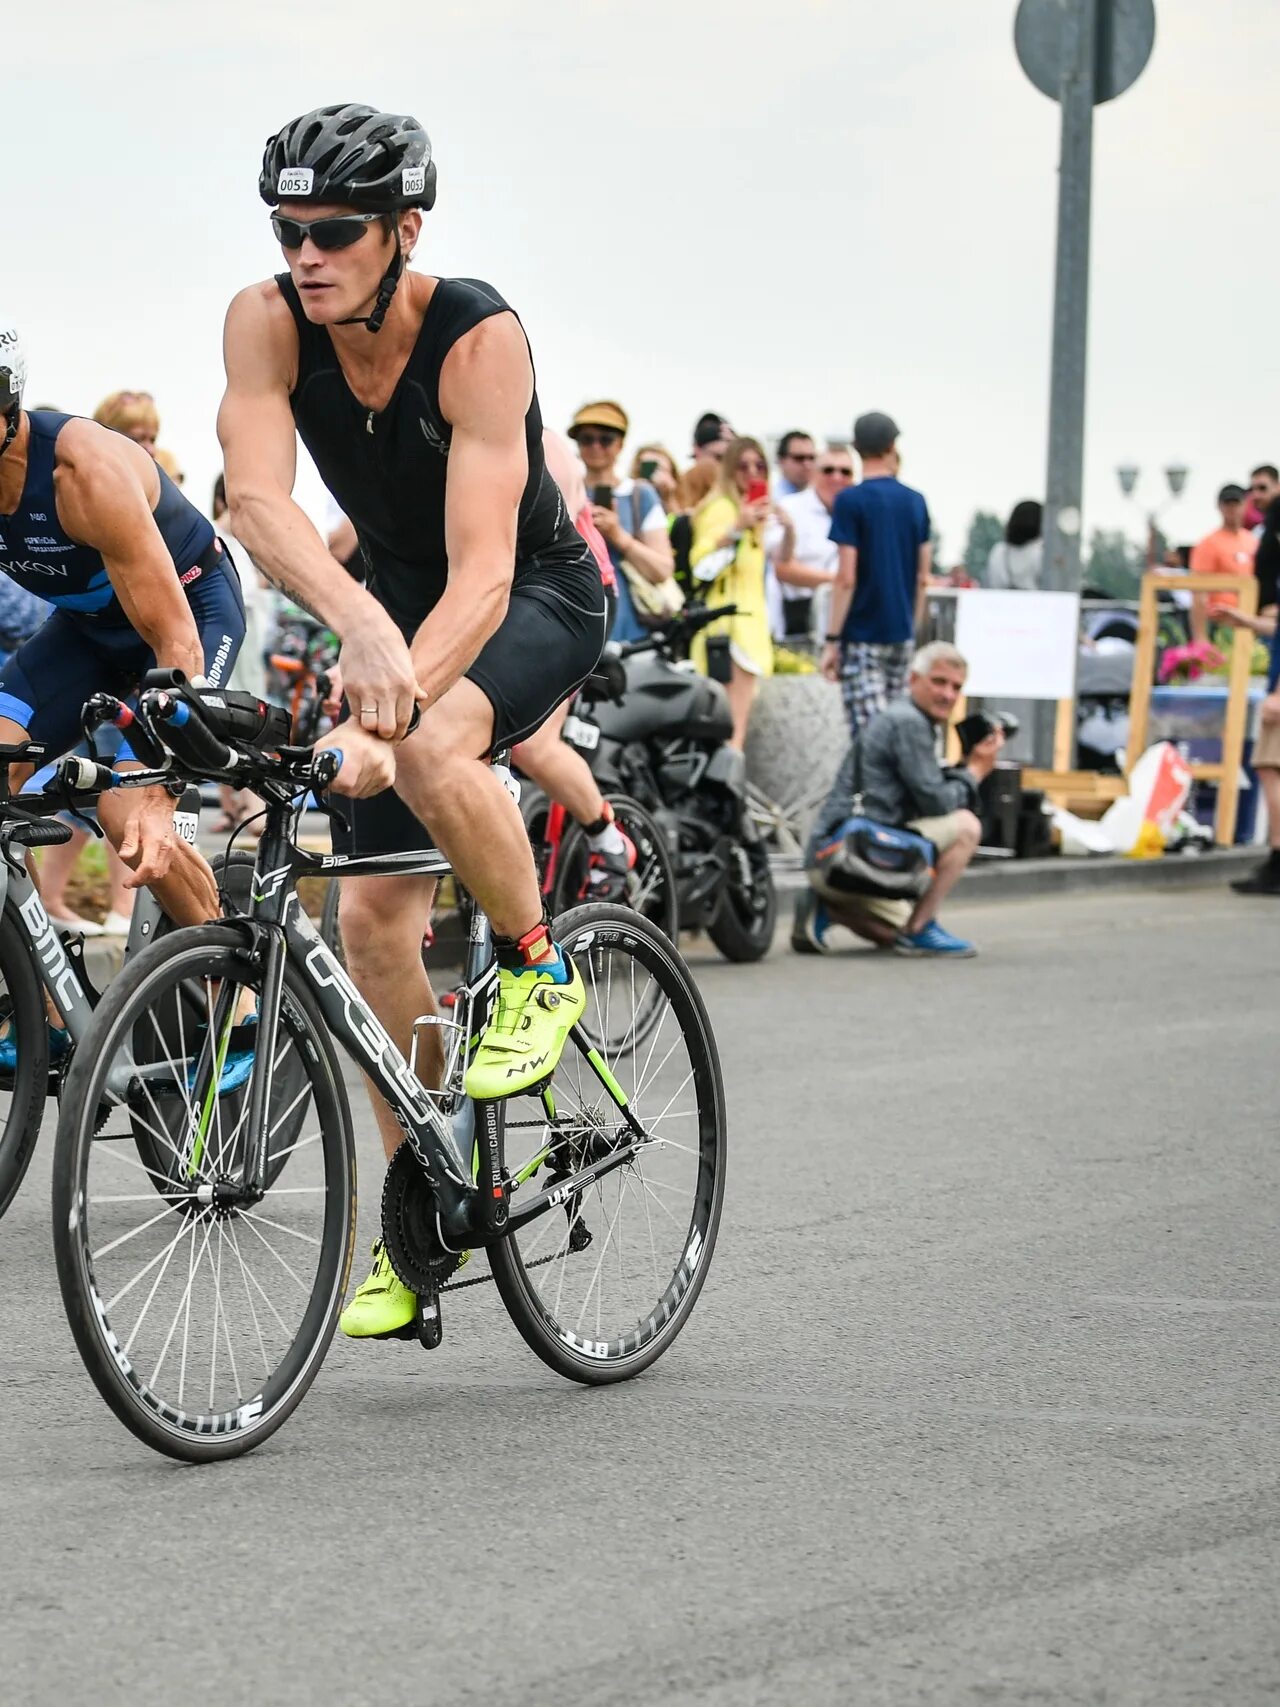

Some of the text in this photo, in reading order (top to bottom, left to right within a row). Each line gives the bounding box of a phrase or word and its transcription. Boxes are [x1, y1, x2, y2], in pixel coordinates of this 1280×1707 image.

[280, 179, 309, 192] 0053
[404, 178, 424, 192] 0053
[18, 888, 84, 1012] BMC
[506, 1051, 550, 1078] NW
